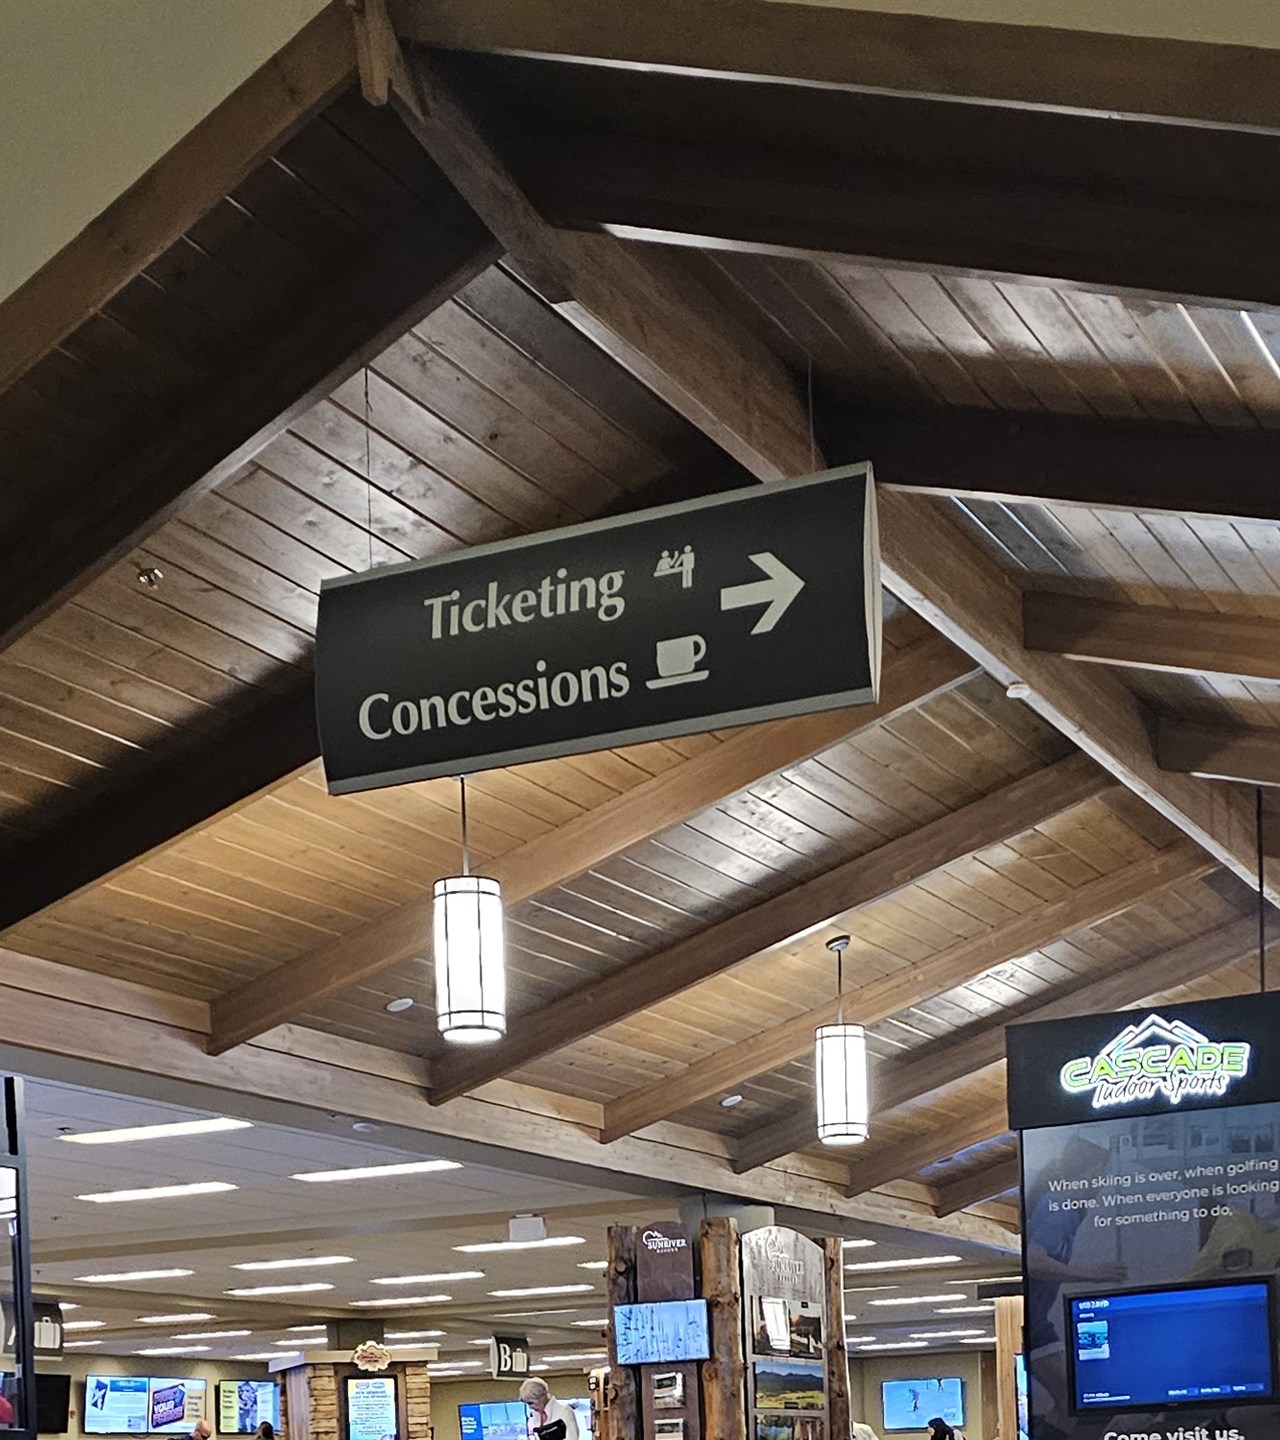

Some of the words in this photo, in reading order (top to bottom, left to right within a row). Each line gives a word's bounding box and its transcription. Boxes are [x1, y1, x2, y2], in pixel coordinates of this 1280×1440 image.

[424, 567, 625, 640] Ticketing
[358, 659, 631, 741] Concessions
[1063, 1044, 1246, 1088] CASCADE
[1096, 1073, 1161, 1102] Indoor
[1164, 1070, 1227, 1099] Sports
[1048, 1178, 1089, 1192] When
[1091, 1174, 1132, 1188] skiing
[1134, 1170, 1146, 1183] is
[1184, 1165, 1224, 1179] when
[1227, 1158, 1279, 1177] golfing
[1048, 1199, 1060, 1212] is
[1062, 1197, 1100, 1210] done.
[1102, 1193, 1143, 1207] When
[1145, 1187, 1210, 1203] everyone
[1212, 1184, 1224, 1196] is
[1226, 1179, 1280, 1195] looking
[1093, 1215, 1112, 1228] for
[1115, 1208, 1190, 1226] something
[1193, 1206, 1208, 1218] to
[647, 1238, 687, 1250] SUNRIVER
[499, 1343, 512, 1371] B
